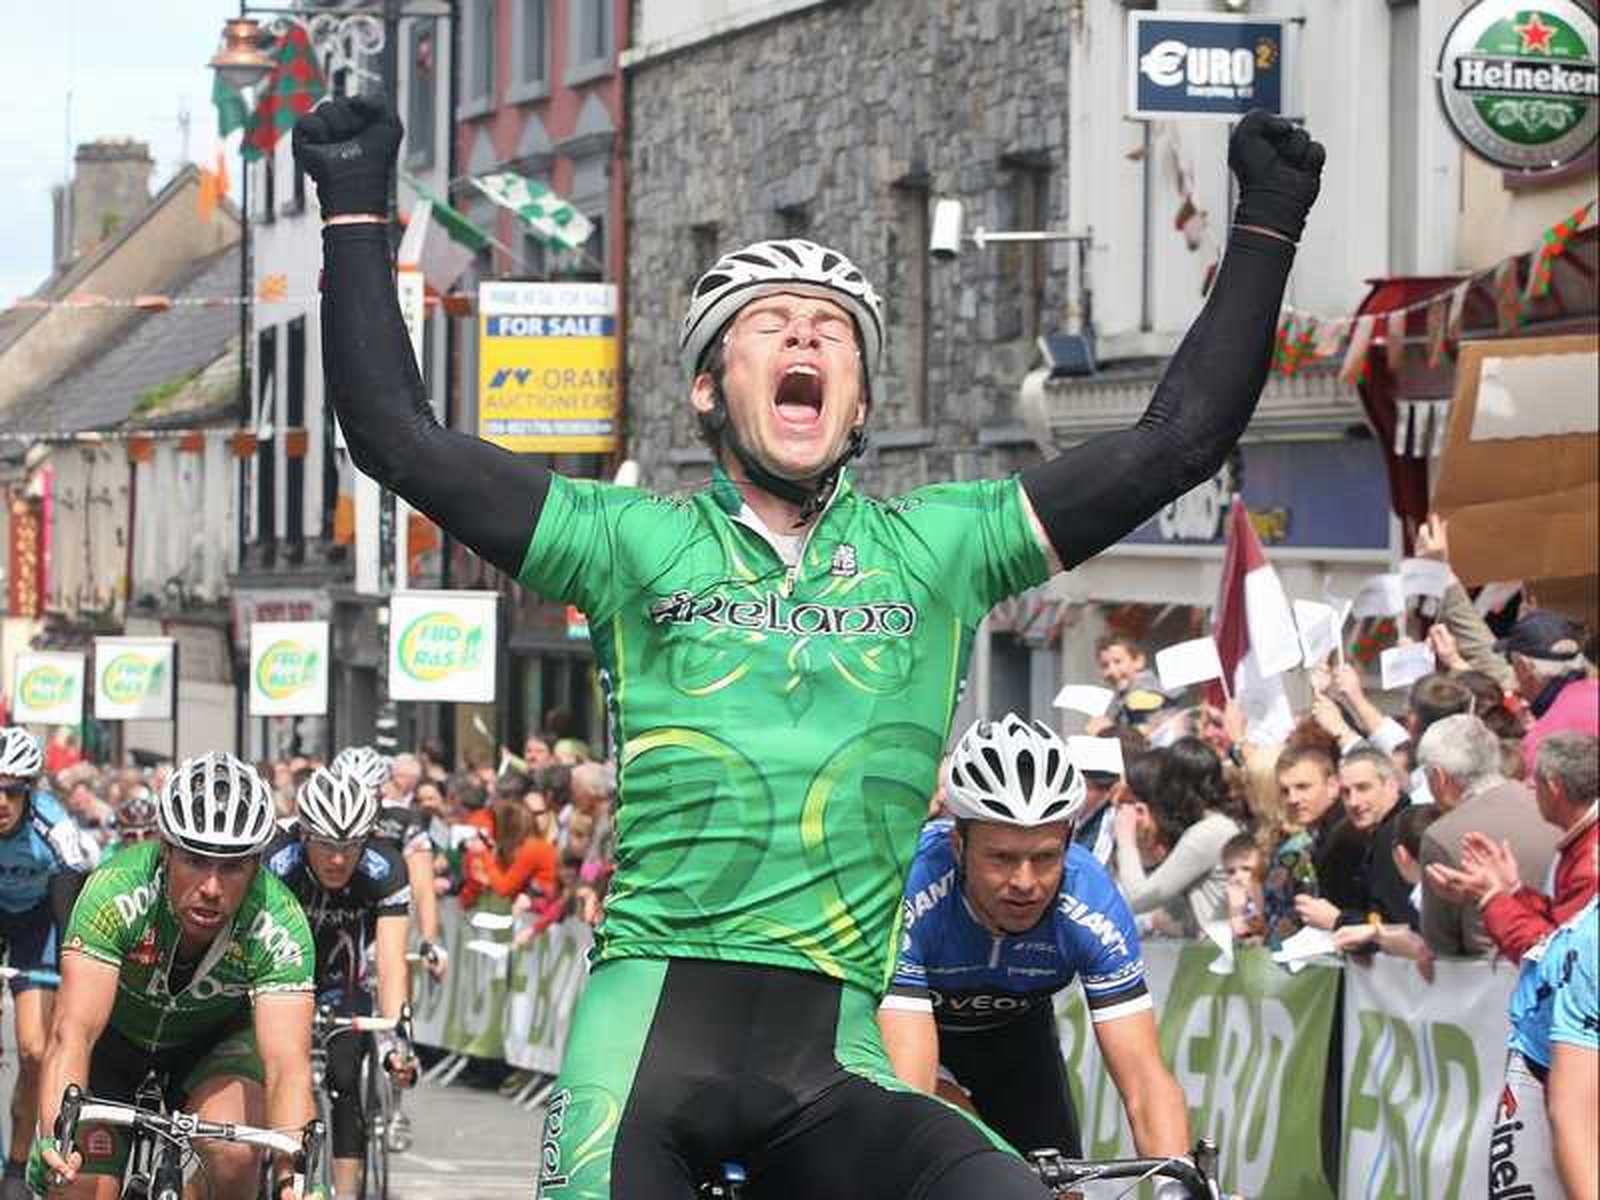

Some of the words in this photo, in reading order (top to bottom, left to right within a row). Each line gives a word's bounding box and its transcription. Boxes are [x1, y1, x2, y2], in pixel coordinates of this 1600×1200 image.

[1459, 59, 1598, 94] Heineken
[499, 317, 545, 337] FOR
[549, 317, 604, 337] SALE
[1058, 893, 1128, 957] GIANT
